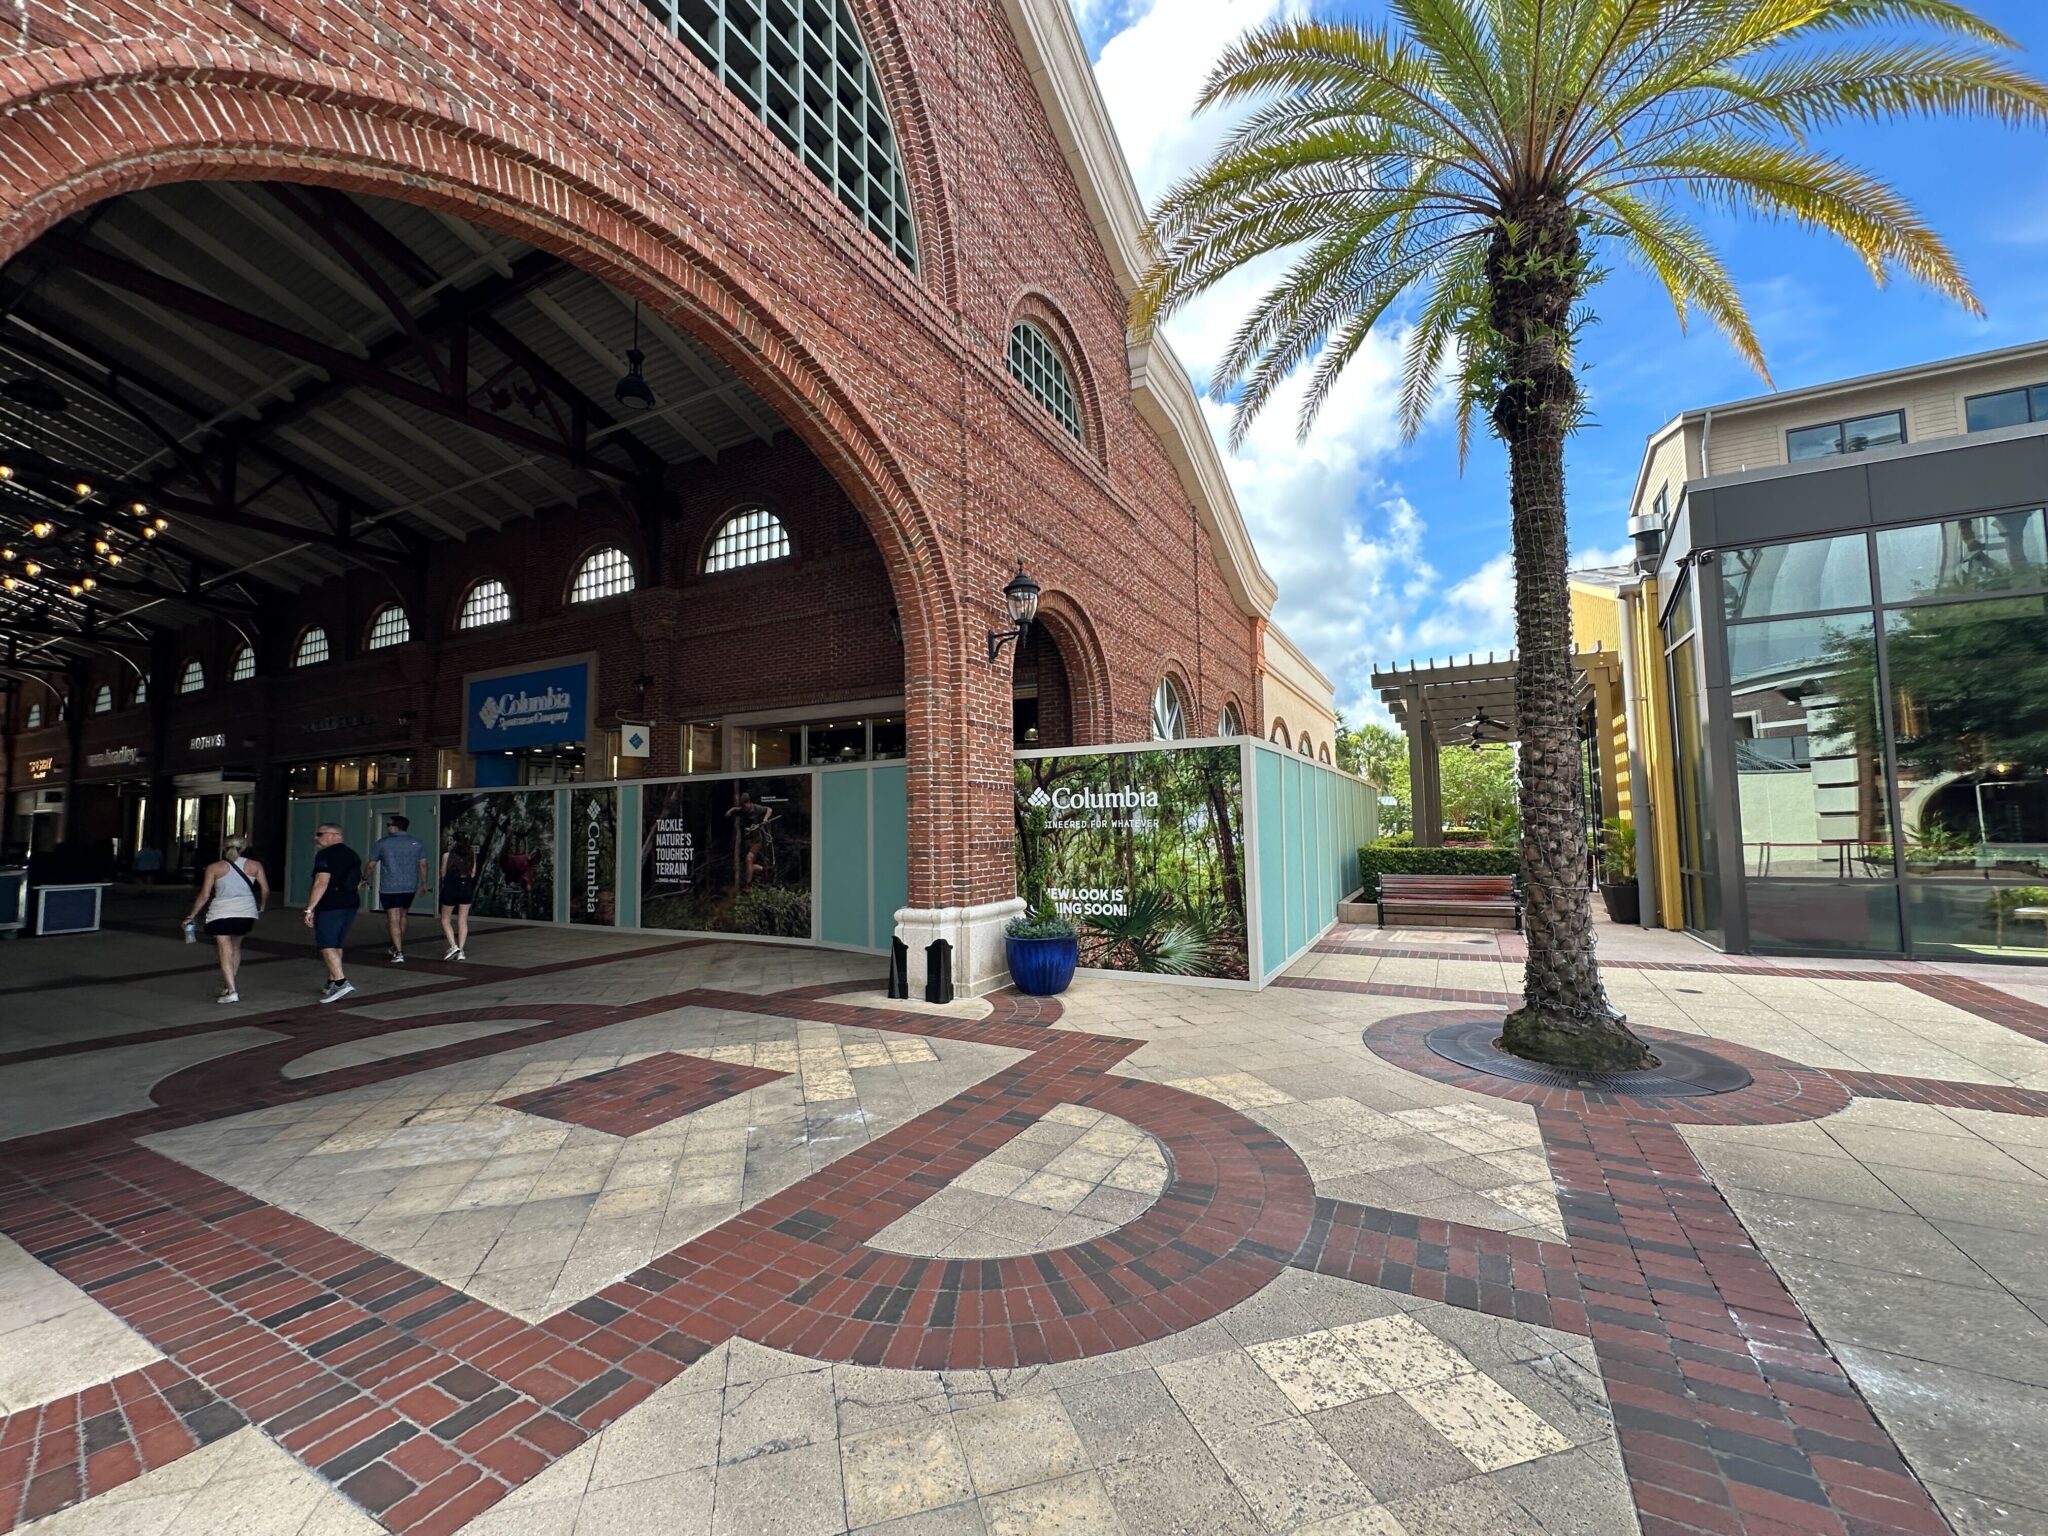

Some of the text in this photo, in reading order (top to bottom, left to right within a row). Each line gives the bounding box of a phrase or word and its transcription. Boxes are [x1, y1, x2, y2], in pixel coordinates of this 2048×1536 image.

[498, 686, 571, 716] Columbia
[1051, 785, 1158, 809] Columbia
[656, 818, 683, 832] TACKLE
[1044, 819, 1159, 829] INEERED FOR WHATEVER
[656, 832, 692, 846] NATURE'S
[655, 847, 694, 861] TOUGHEST
[586, 821, 600, 913] Columbia
[655, 862, 688, 876] TERRAIN
[1072, 888, 1109, 901] LOOK
[1112, 889, 1123, 902] IS
[1084, 903, 1128, 916] SOON!
